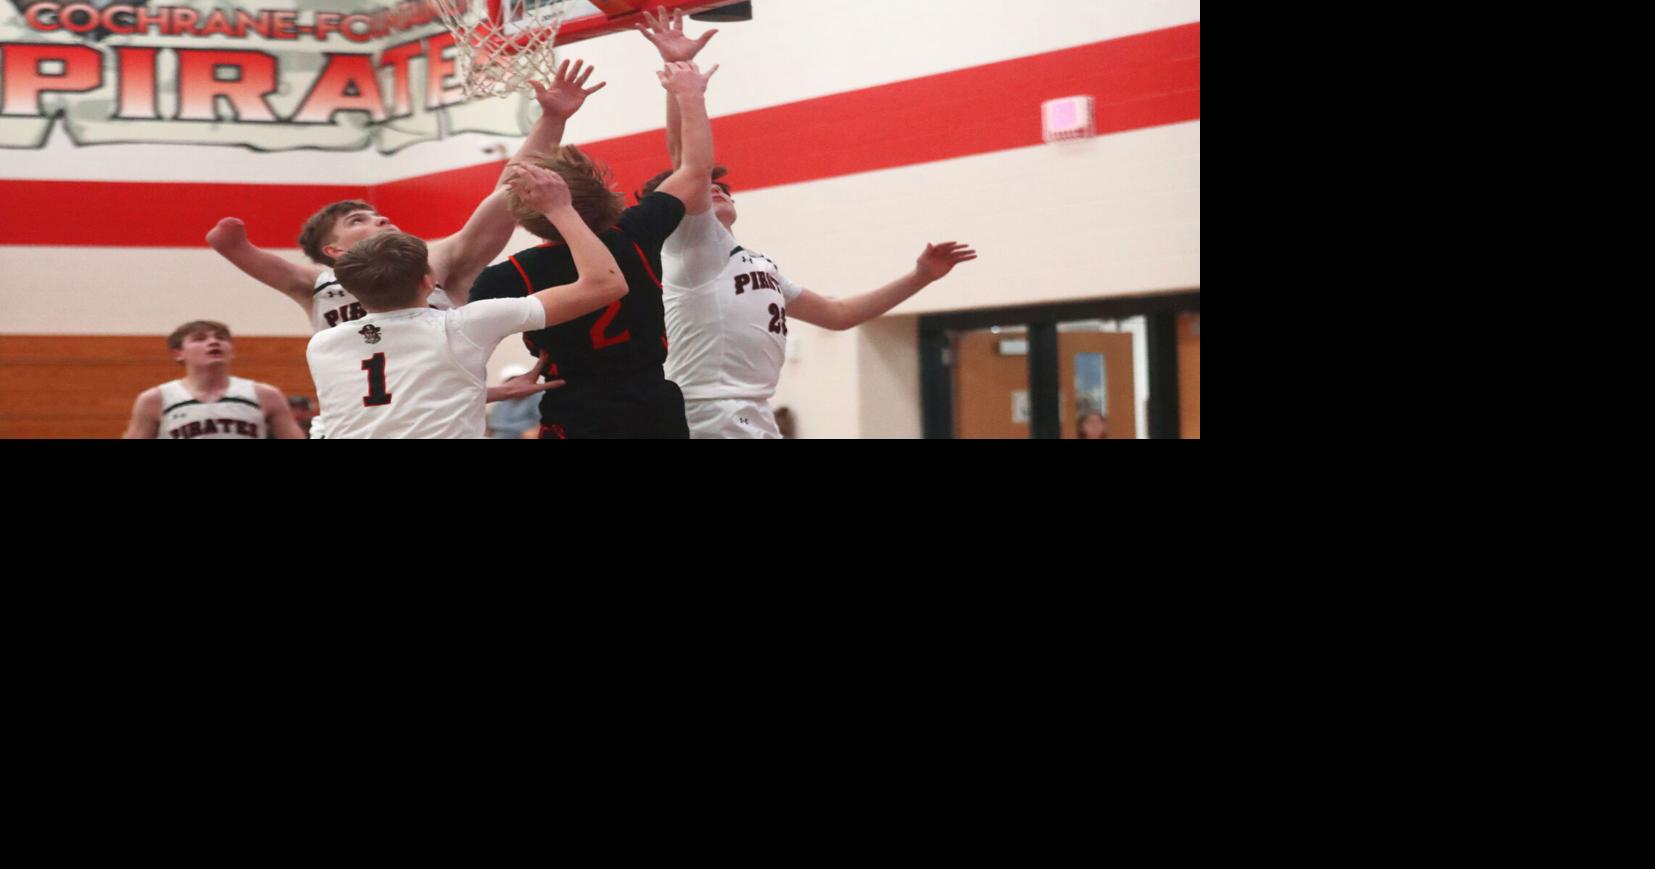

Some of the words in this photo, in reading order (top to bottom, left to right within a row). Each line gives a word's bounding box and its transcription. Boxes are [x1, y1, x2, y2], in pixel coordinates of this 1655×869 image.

[25, 2, 467, 43] COCHRANE-FO
[590, 299, 631, 350] 2
[361, 352, 392, 407] 1
